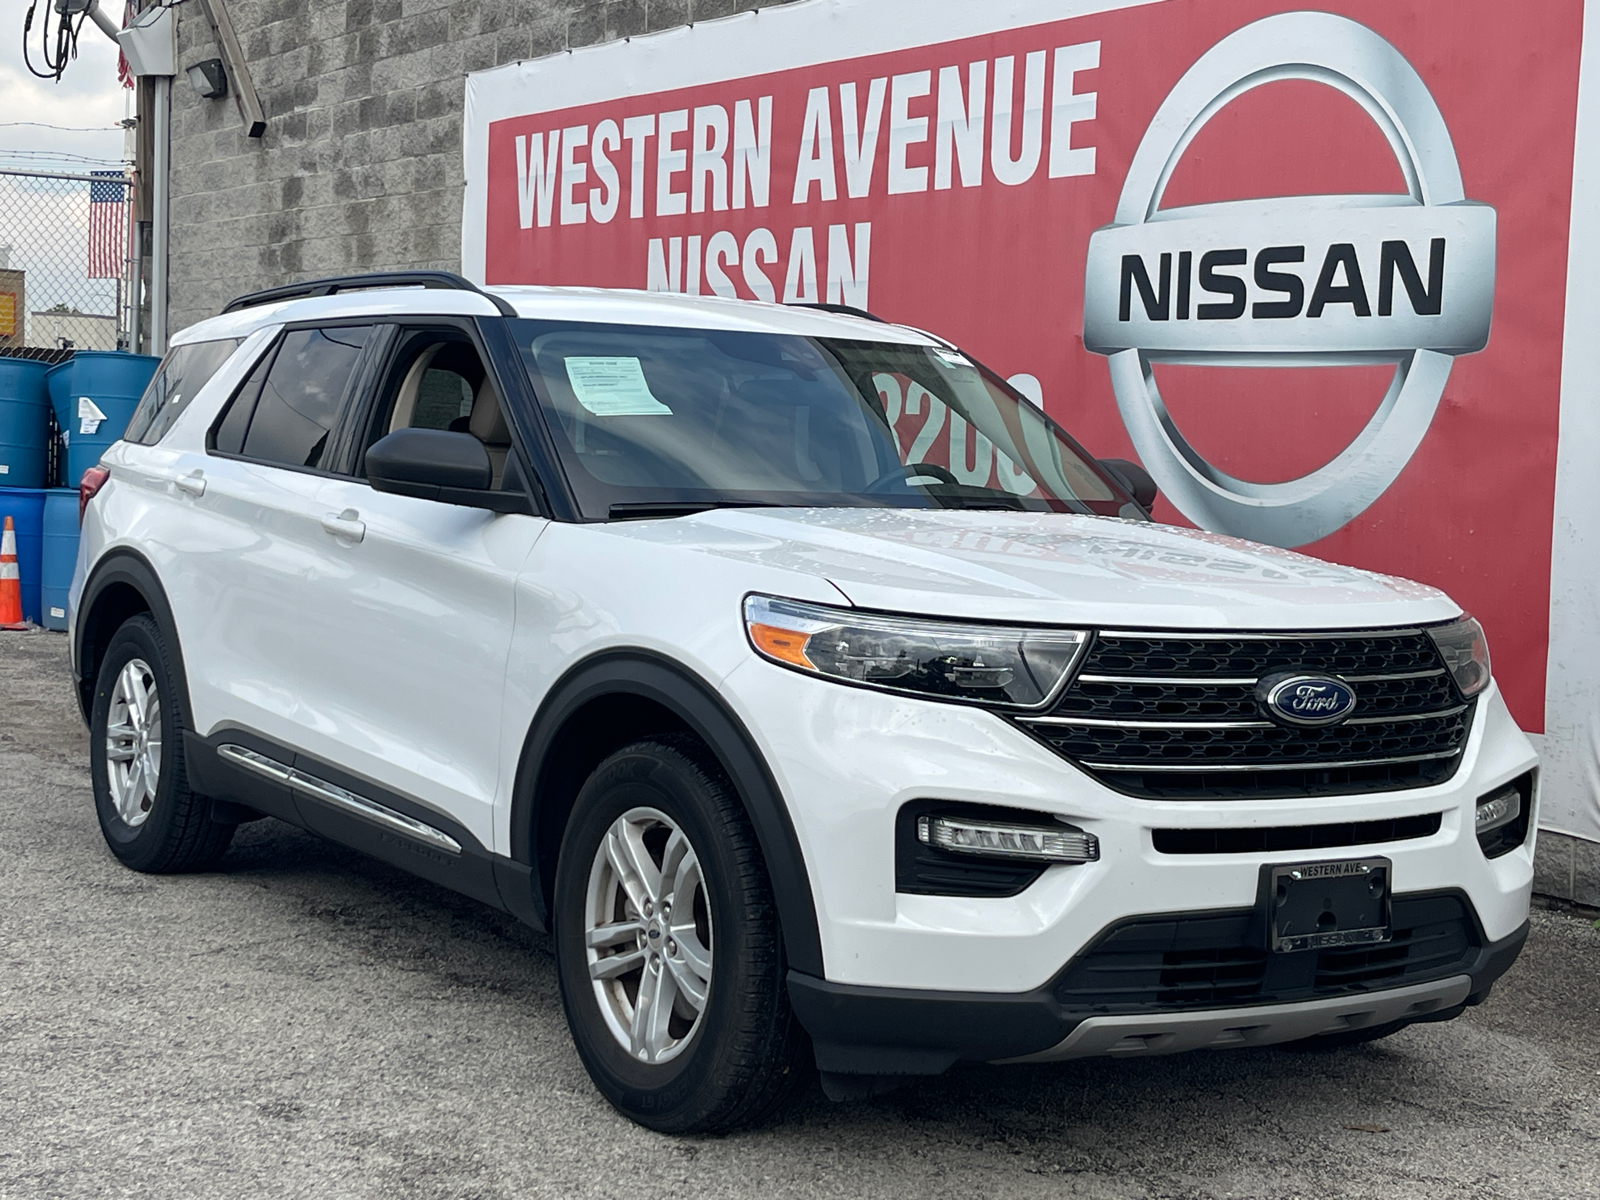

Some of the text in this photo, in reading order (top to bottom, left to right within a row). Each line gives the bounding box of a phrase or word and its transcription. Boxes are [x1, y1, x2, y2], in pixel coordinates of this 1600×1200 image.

[515, 40, 1101, 229] WESTERN AVENUE
[647, 222, 871, 312] NISSAN
[1118, 238, 1446, 321] NISSAN
[1293, 685, 1339, 712] Ford
[1300, 862, 1361, 877] WESTERN AVE
